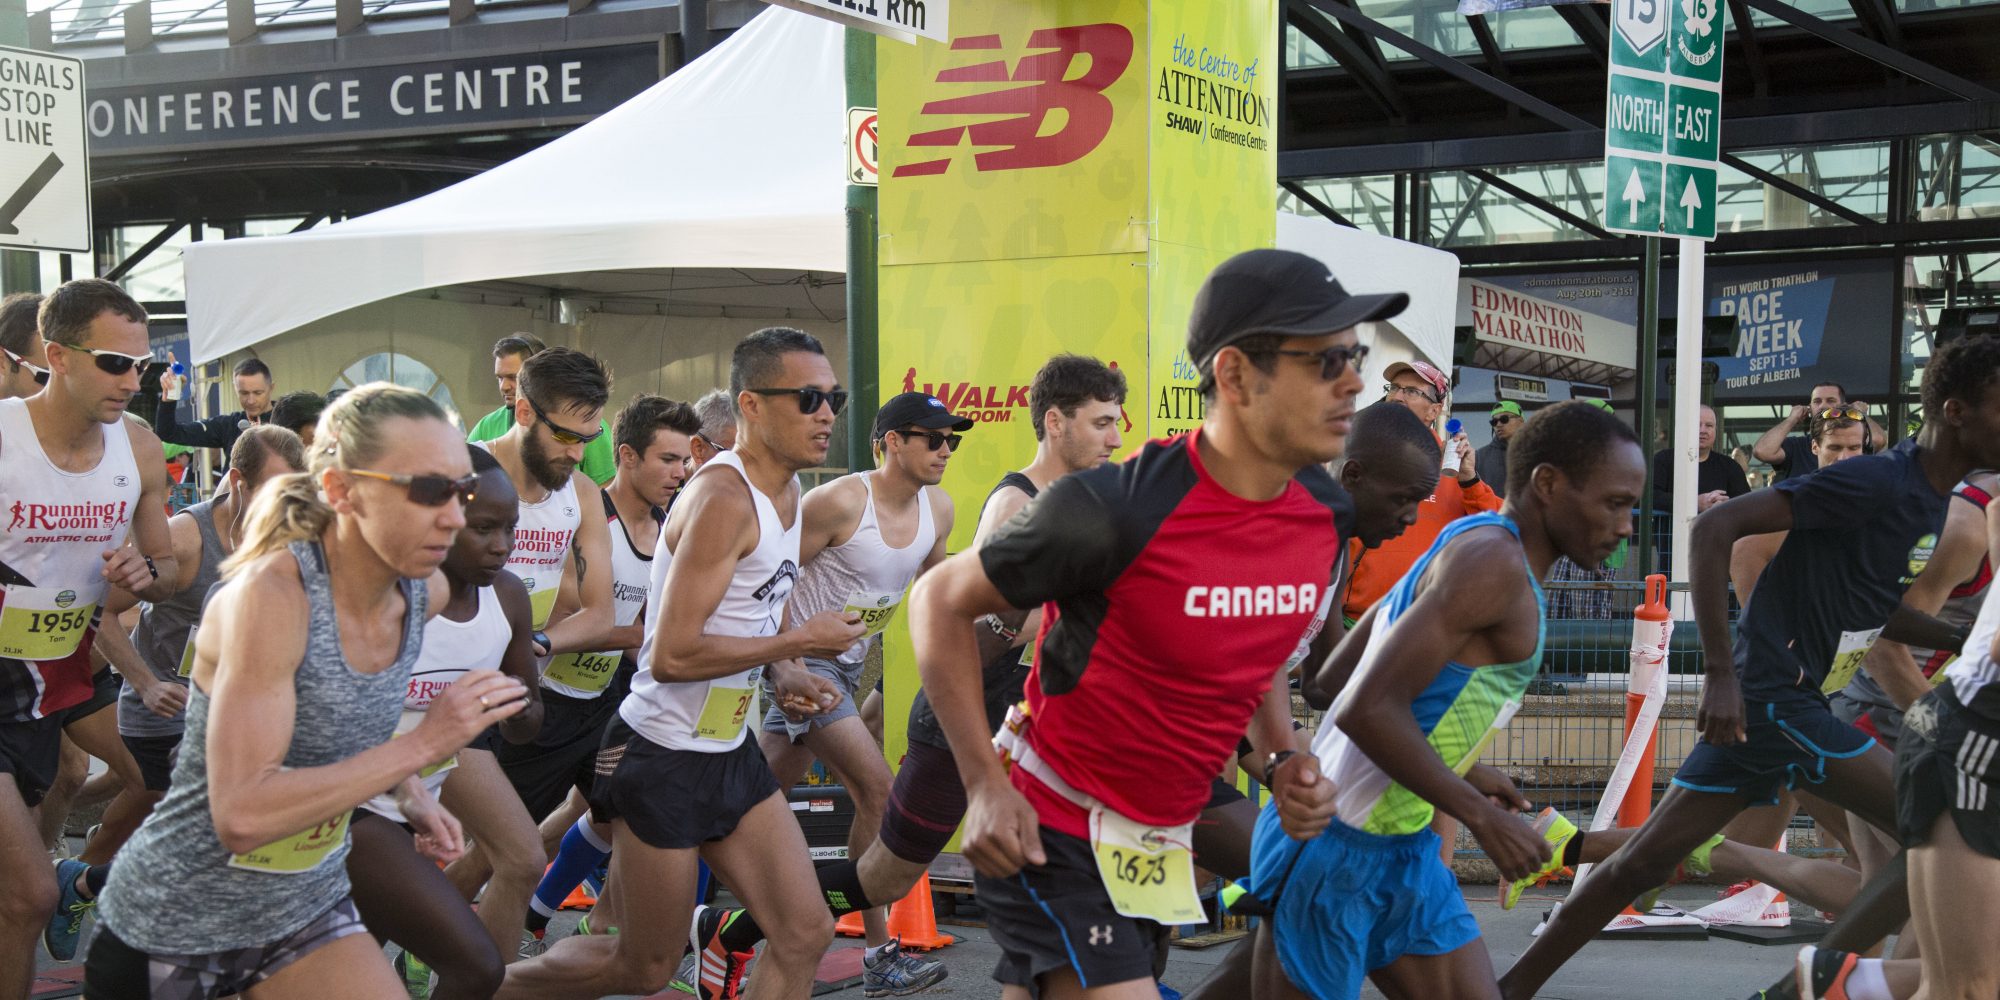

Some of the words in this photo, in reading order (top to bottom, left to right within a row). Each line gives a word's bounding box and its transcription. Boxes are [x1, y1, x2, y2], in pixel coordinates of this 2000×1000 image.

[1628, 0, 1657, 25] 15
[1173, 33, 1197, 68] the
[1200, 47, 1240, 82] Centre
[1242, 57, 1258, 105] of
[1681, 46, 1712, 65] ALBERTA
[0, 57, 75, 91] GNALS
[0, 87, 57, 117] STOP
[88, 80, 361, 138] ONFERENCE
[389, 61, 583, 116] CENTRE
[1157, 66, 1271, 129] ATTENTION
[1611, 92, 1664, 136] NORTH
[1675, 103, 1713, 143] EAST
[5, 117, 54, 147] LINE
[1166, 111, 1203, 135] SHAW
[1210, 122, 1247, 147] Conference
[1246, 131, 1268, 152] Centre
[1523, 274, 1633, 288] edmontonmarathon.ca
[1556, 289, 1576, 301] Aug
[1579, 287, 1602, 299] 20th
[1723, 286, 1737, 298] ITU
[1739, 279, 1769, 294] WORLD
[1771, 270, 1819, 289] TRIATHLON
[1471, 284, 1584, 333] EDMONTON
[1472, 310, 1586, 355] MARATHON
[1173, 349, 1196, 381] the
[1749, 354, 1778, 372] SEPT
[1780, 351, 1797, 367] 1-5
[1726, 375, 1749, 389] TOUR
[1750, 373, 1762, 386] OF
[1763, 367, 1801, 384] ALBERTA
[27, 500, 116, 531] Running
[24, 535, 81, 544] ATHLETIC
[84, 534, 113, 543] CLUB
[860, 606, 893, 623] 1587
[1184, 582, 1317, 618] CANADA
[28, 609, 85, 633] 1956
[49, 635, 66, 643] Tom
[571, 651, 612, 673] 1466
[1112, 850, 1166, 887] 2673
